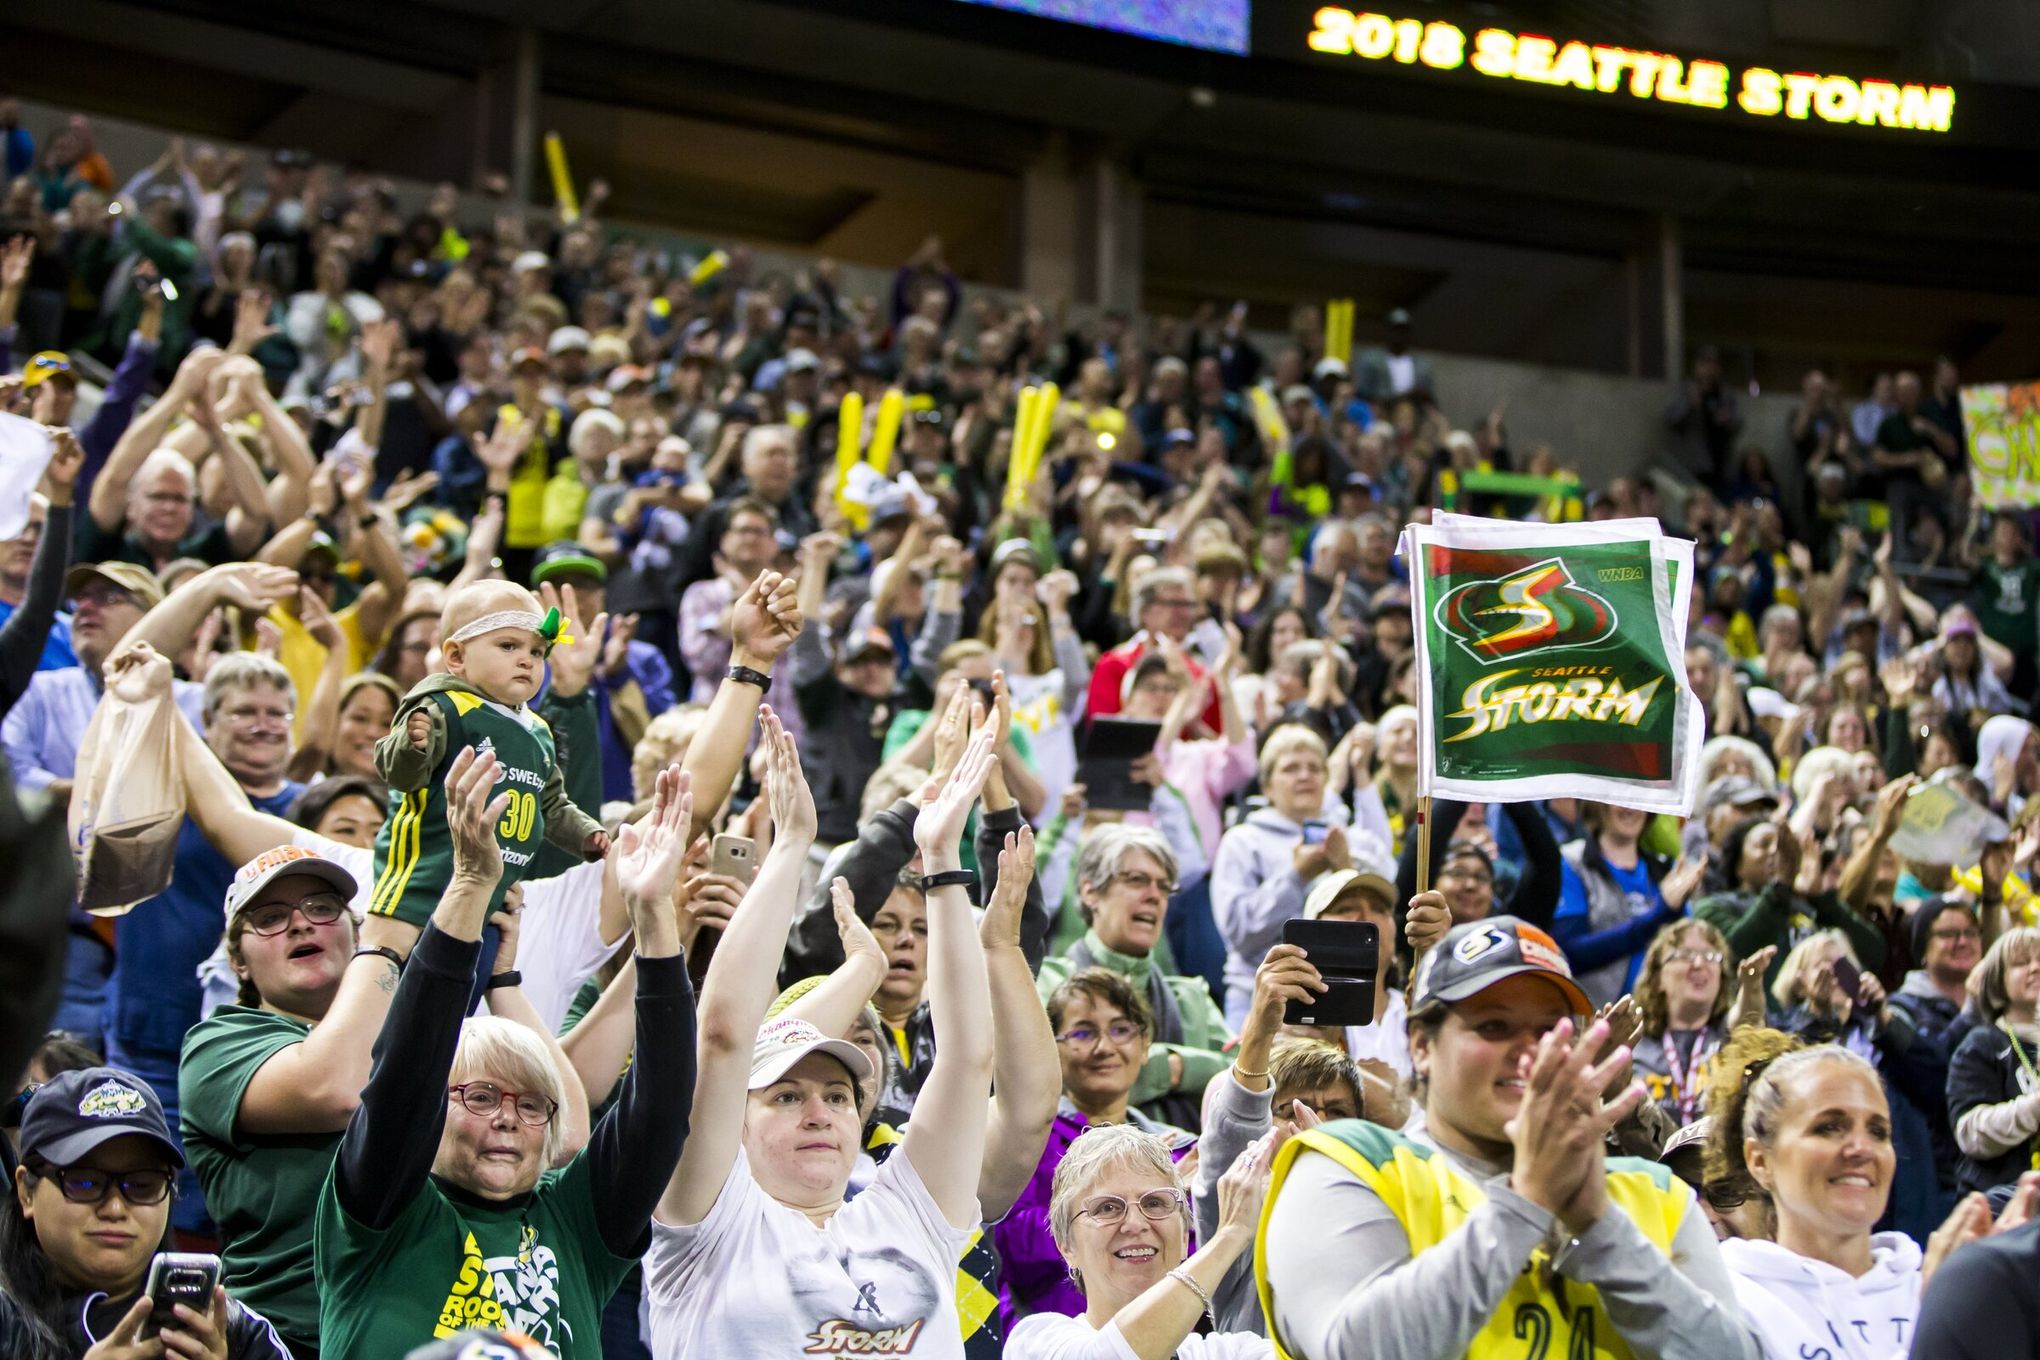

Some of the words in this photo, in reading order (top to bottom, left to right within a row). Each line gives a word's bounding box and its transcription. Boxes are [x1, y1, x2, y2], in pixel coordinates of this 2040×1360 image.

[1308, 6, 1466, 69] 2018
[1471, 28, 1728, 109] SEATTLE
[1738, 66, 1956, 132] STORM
[1597, 566, 1645, 583] WNBA
[1532, 665, 1613, 678] SEATTLE
[1442, 669, 1665, 743] STORM
[500, 788, 536, 842] 30
[439, 1313, 463, 1329] OF
[804, 1317, 926, 1355] STORM
[1514, 1302, 1595, 1360] 24
